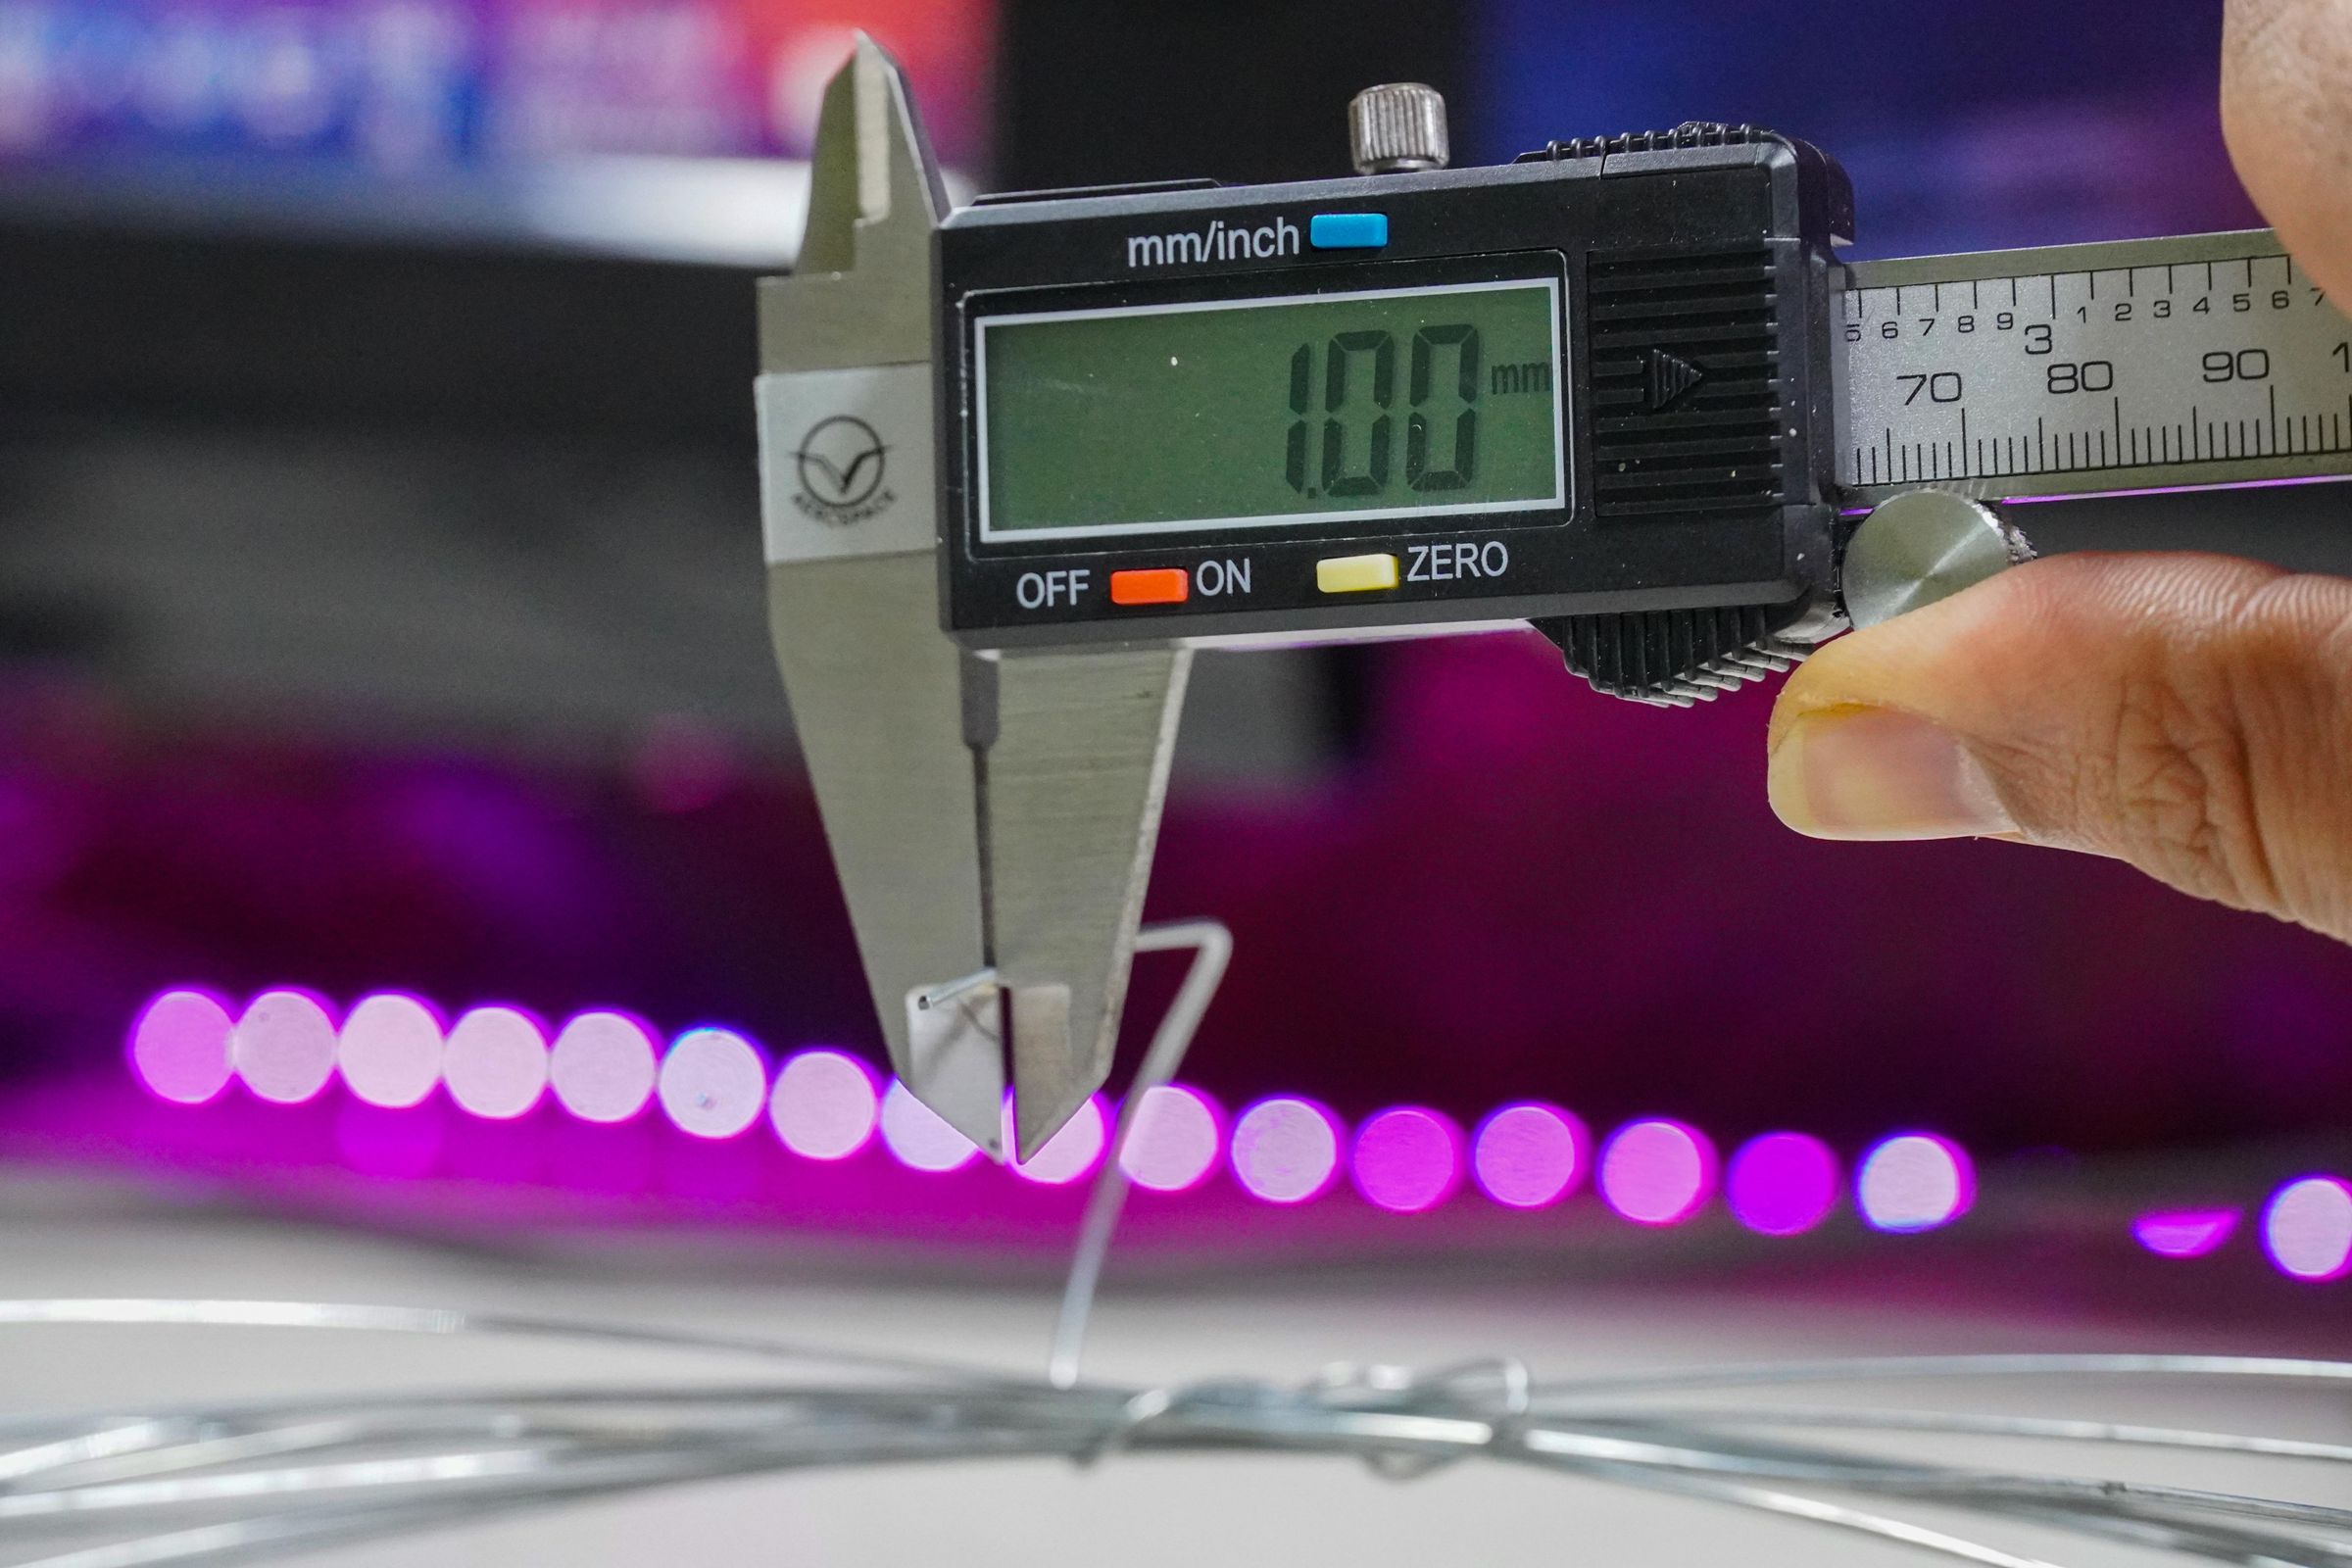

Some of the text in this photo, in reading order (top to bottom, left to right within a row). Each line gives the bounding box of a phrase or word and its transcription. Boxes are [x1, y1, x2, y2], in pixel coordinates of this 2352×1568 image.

[1128, 217, 1300, 268] mm/inch
[1882, 321, 1898, 339] 6
[1919, 318, 1936, 336] 7
[1958, 316, 1975, 333] 8
[1996, 313, 2014, 330] 9
[2024, 324, 2052, 355] 3
[2077, 307, 2086, 323] 1
[2115, 304, 2132, 321] 2
[2154, 301, 2171, 318] 3
[2192, 297, 2211, 315] 4
[2233, 294, 2250, 312] 5
[2272, 291, 2289, 309] 6
[1491, 361, 1551, 394] mm
[1896, 371, 1962, 405] 70
[2047, 361, 2113, 393] 80
[2202, 349, 2270, 382] 90
[1016, 559, 1250, 610] OFF ON
[1406, 541, 1509, 582] ZERO
